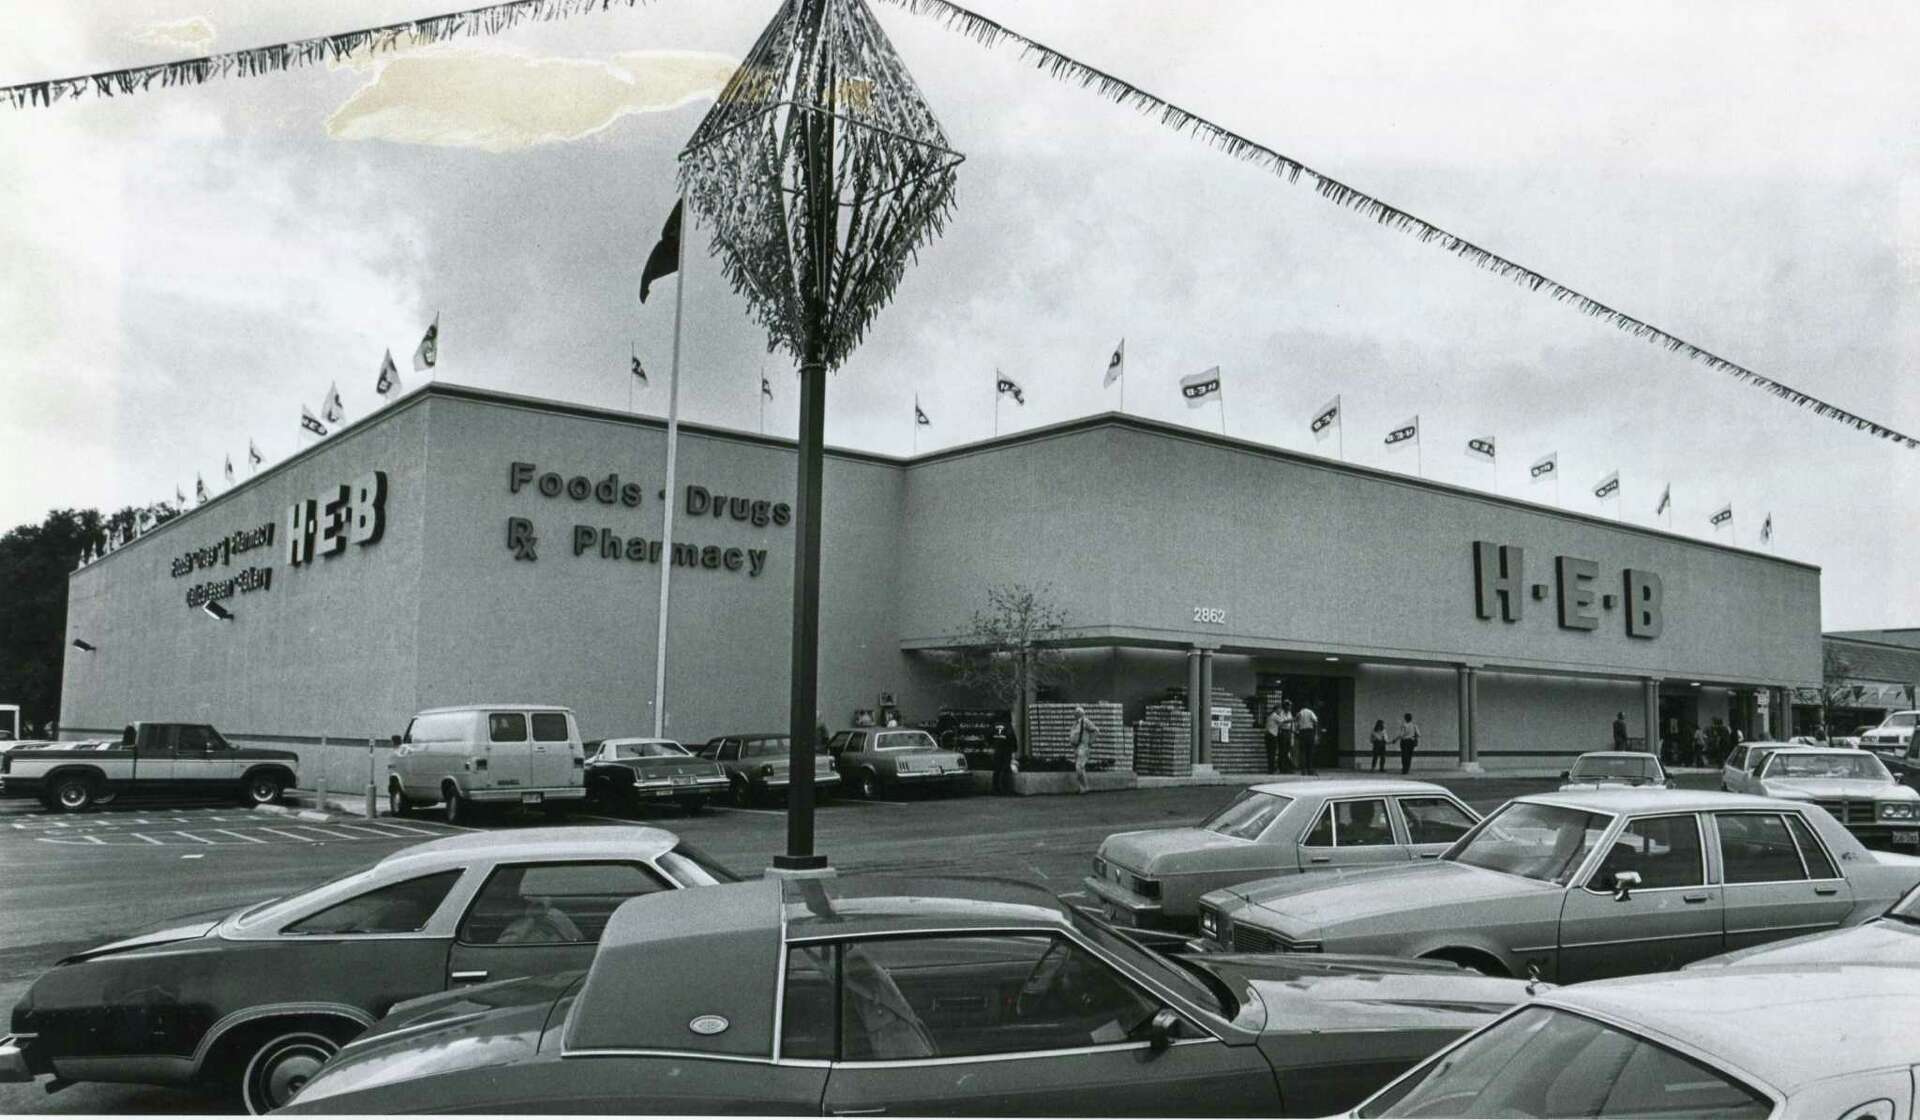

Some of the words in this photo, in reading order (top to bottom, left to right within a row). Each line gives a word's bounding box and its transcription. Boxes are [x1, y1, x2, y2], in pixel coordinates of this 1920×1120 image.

[510, 461, 642, 508] Foods
[686, 485, 791, 527] Drugs
[573, 524, 768, 577] Pharmacy
[1193, 607, 1225, 624] 2862
